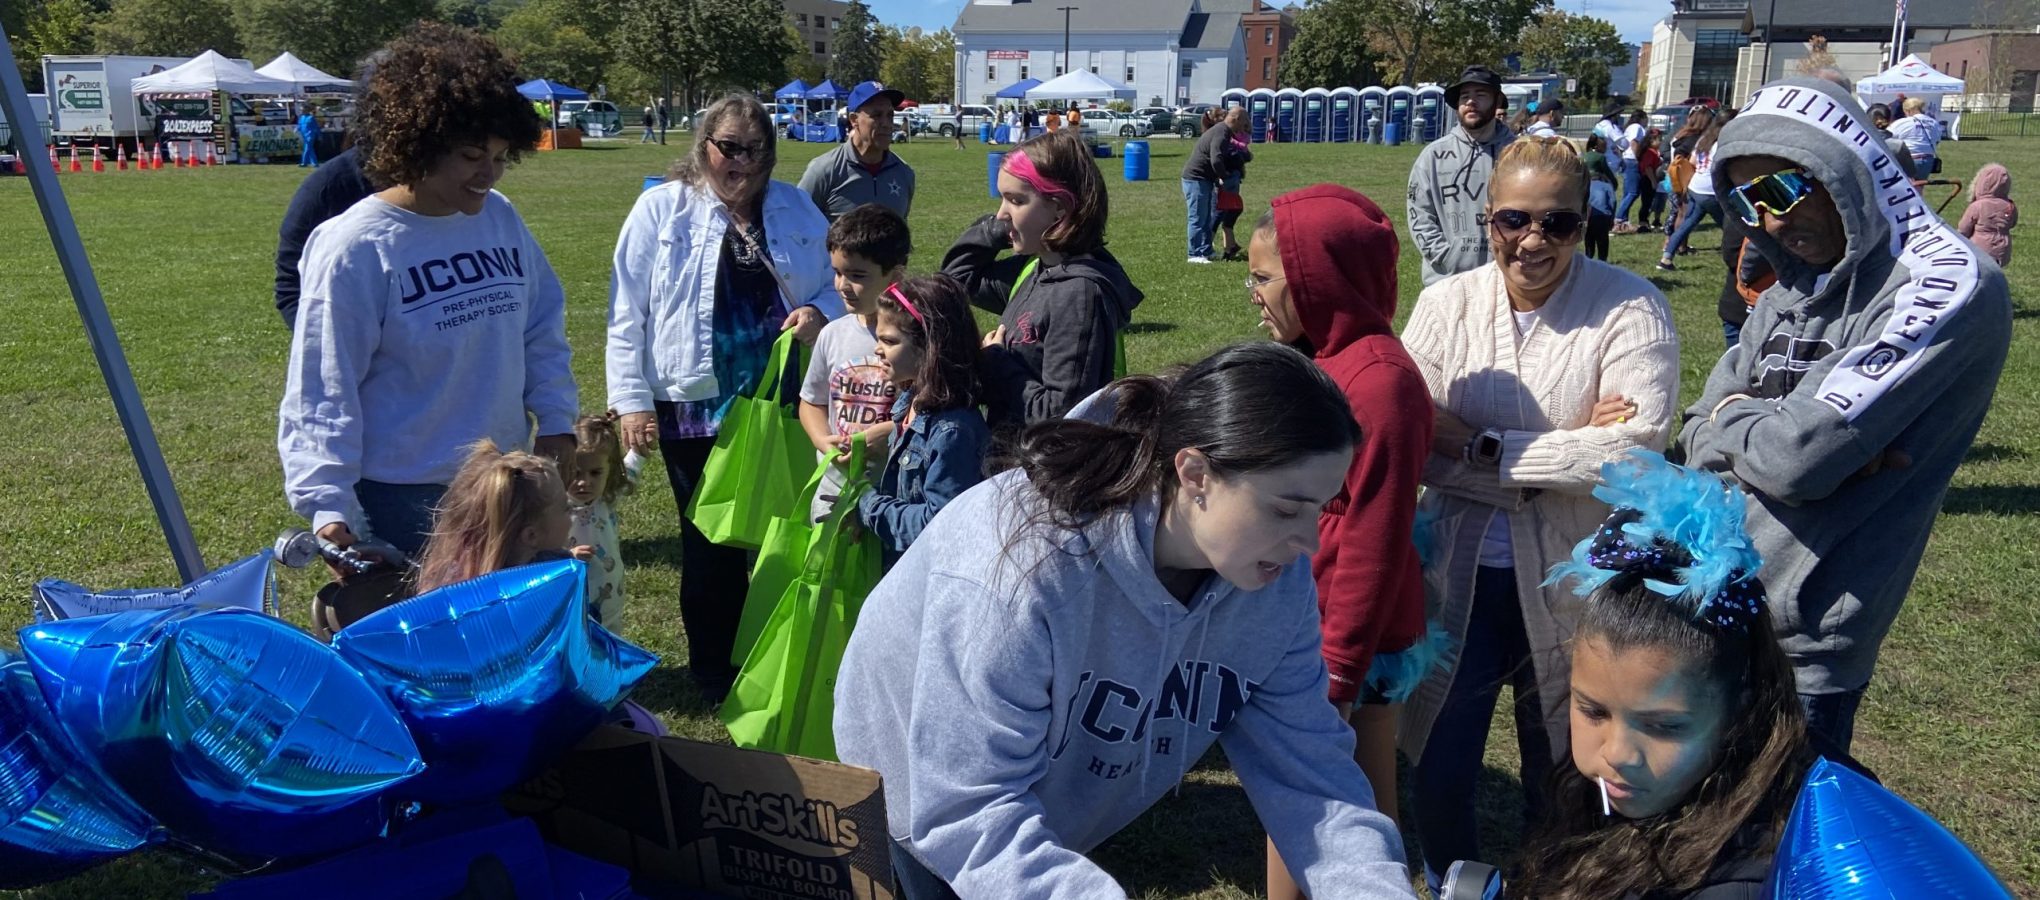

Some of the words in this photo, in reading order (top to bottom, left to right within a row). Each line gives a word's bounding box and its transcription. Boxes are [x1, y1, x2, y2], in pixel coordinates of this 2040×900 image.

[73, 81, 101, 89] SUPERIOR
[245, 137, 300, 153] LEMONADE
[398, 247, 524, 304] UCONN
[442, 290, 514, 316] PRE-PHYSICAL
[435, 309, 485, 332] THERAPY
[839, 376, 897, 398] Hustle
[838, 404, 860, 424] All
[701, 784, 860, 848] ArtSkills
[728, 844, 838, 886] TRIFOLD
[722, 863, 789, 891] DISPLAY
[793, 878, 851, 900] BOARD
